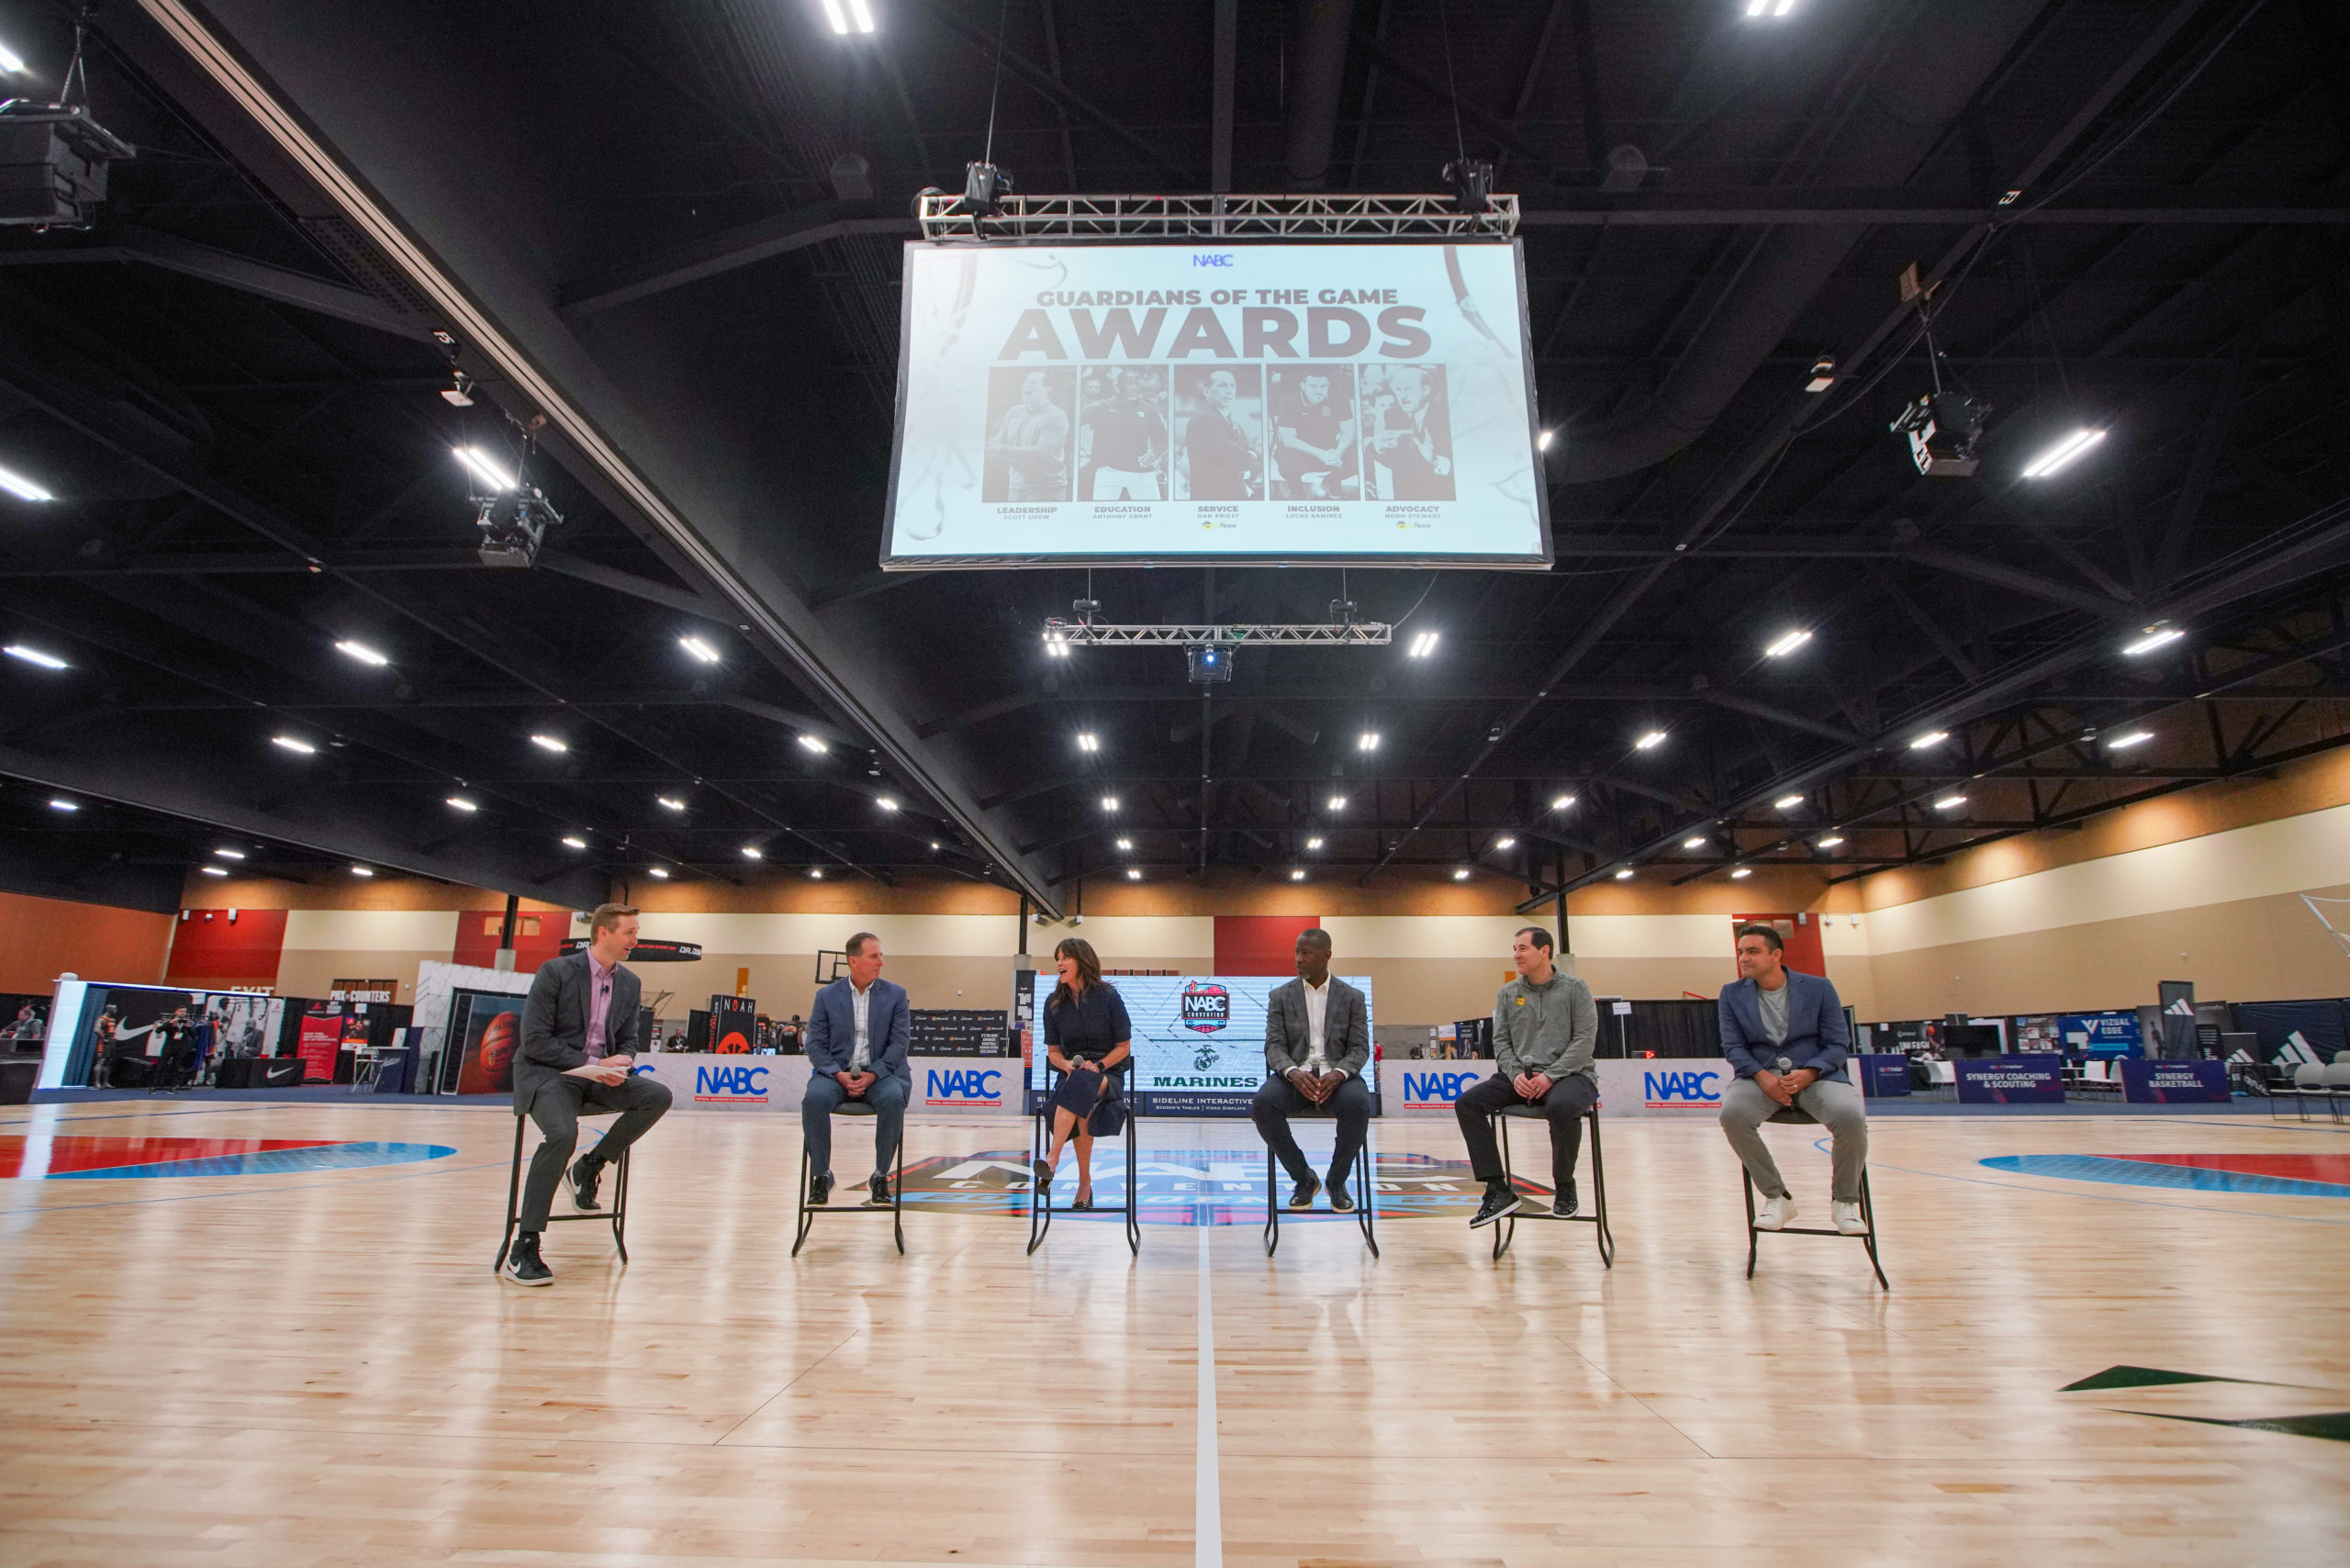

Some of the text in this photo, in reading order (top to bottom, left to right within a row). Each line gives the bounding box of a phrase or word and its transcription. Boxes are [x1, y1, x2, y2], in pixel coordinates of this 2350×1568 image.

[1193, 254, 1234, 267] NABC
[1036, 288, 1399, 307] GUARDIANS OF THE GAME
[997, 306, 1432, 361] AWARDS
[1385, 505, 1440, 513] ADVOCACY
[723, 998, 754, 1014] NOAH
[1185, 996, 1226, 1012] NABC
[696, 1066, 769, 1095] NABC
[927, 1070, 1002, 1099] NABC
[1153, 1076, 1259, 1088] MARINES
[1966, 1072, 2052, 1081] SYNERGY COACHING
[2149, 1080, 2204, 1088] BASKETBALL
[2154, 1072, 2194, 1081] SYNERGY
[1644, 1071, 1721, 1101] NABC
